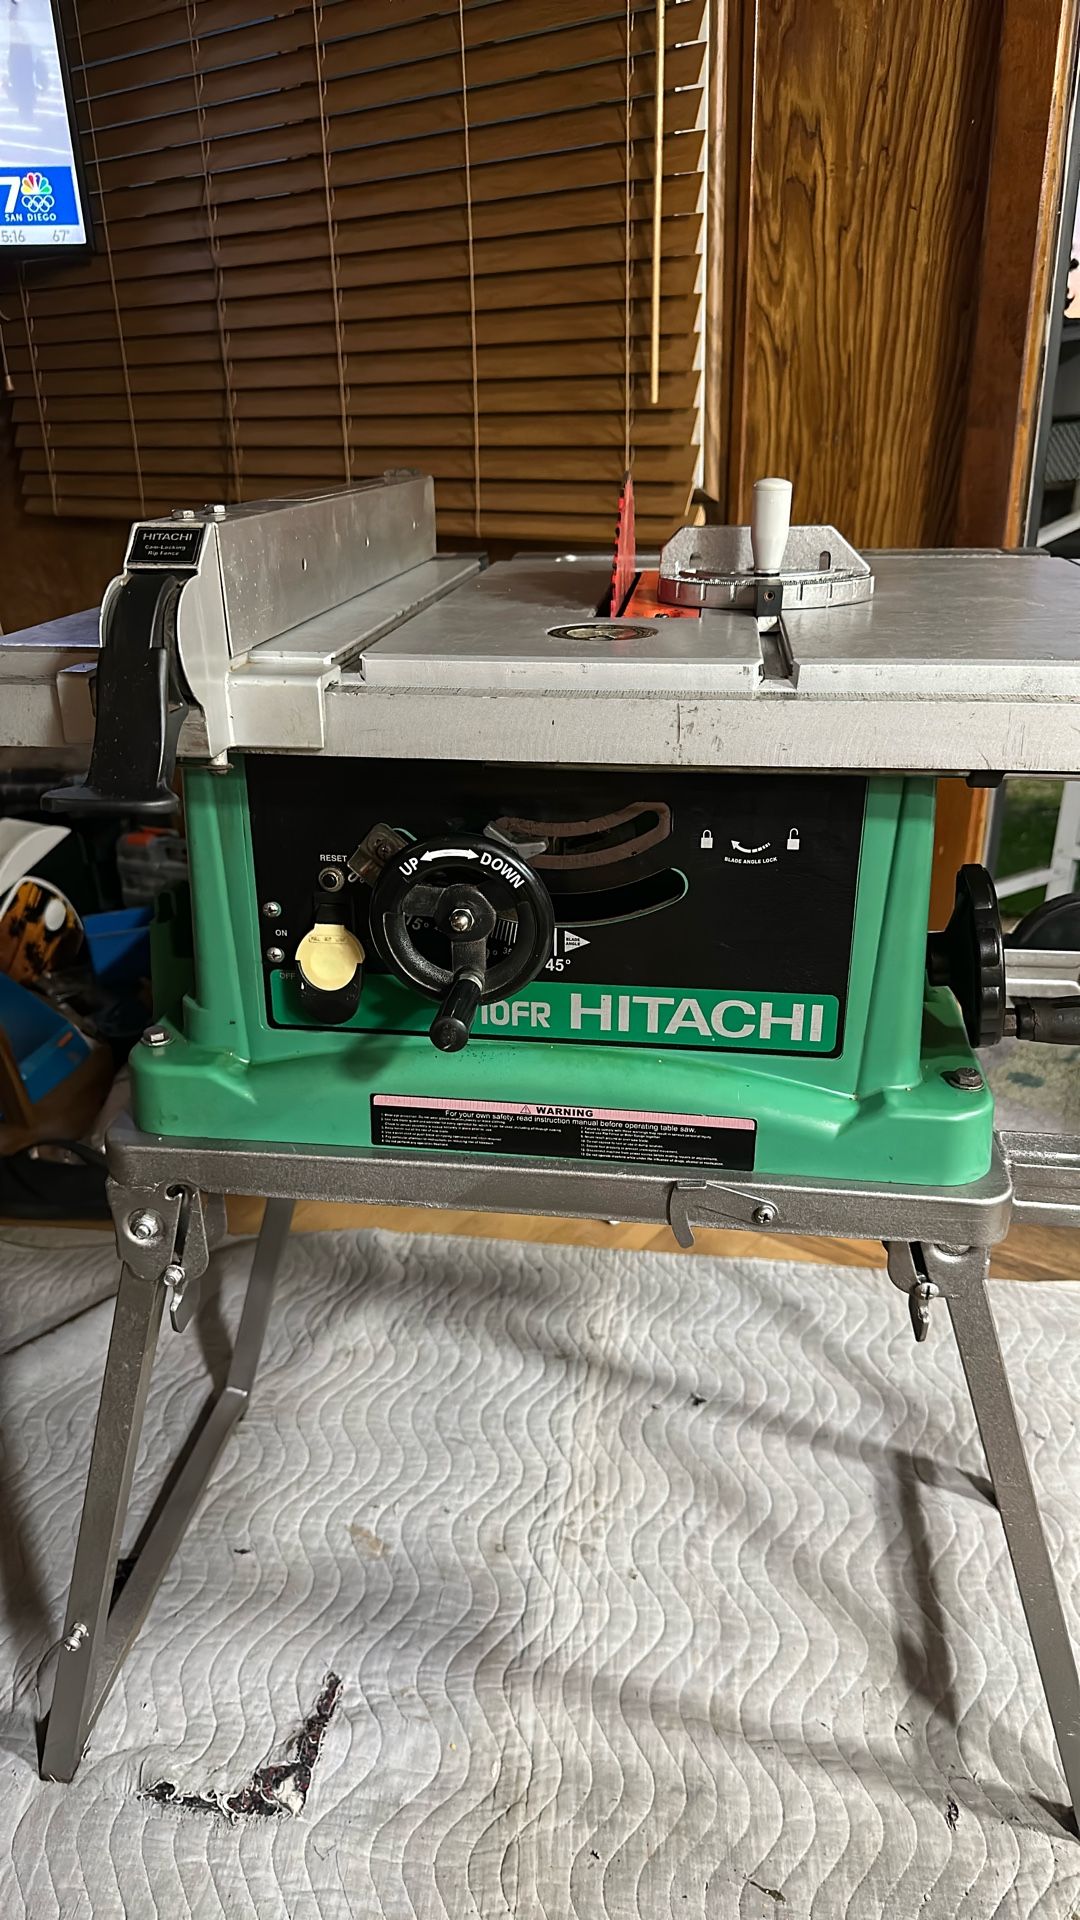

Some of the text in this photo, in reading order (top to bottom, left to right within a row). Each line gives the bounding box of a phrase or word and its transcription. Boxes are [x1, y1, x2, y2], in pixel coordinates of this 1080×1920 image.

[5, 213, 56, 222] SAN DIEGO
[1, 230, 26, 242] 5:16
[143, 533, 193, 541] HITACHI
[319, 854, 348, 862] RESET
[724, 856, 742, 864] BLADE
[763, 856, 778, 864] LOCK
[399, 852, 525, 889] UP DOWN
[275, 929, 288, 937] ON
[545, 958, 571, 972] 45°
[279, 971, 297, 980] OFF
[570, 993, 824, 1042] HITACHI
[536, 1106, 594, 1118] WARNING
[445, 1109, 458, 1117] For
[458, 1111, 475, 1120] your
[492, 1113, 515, 1122] safety,
[534, 1116, 571, 1125] instruction
[572, 1118, 599, 1126] manual
[600, 1120, 624, 1128] before
[624, 1122, 659, 1132] operating
